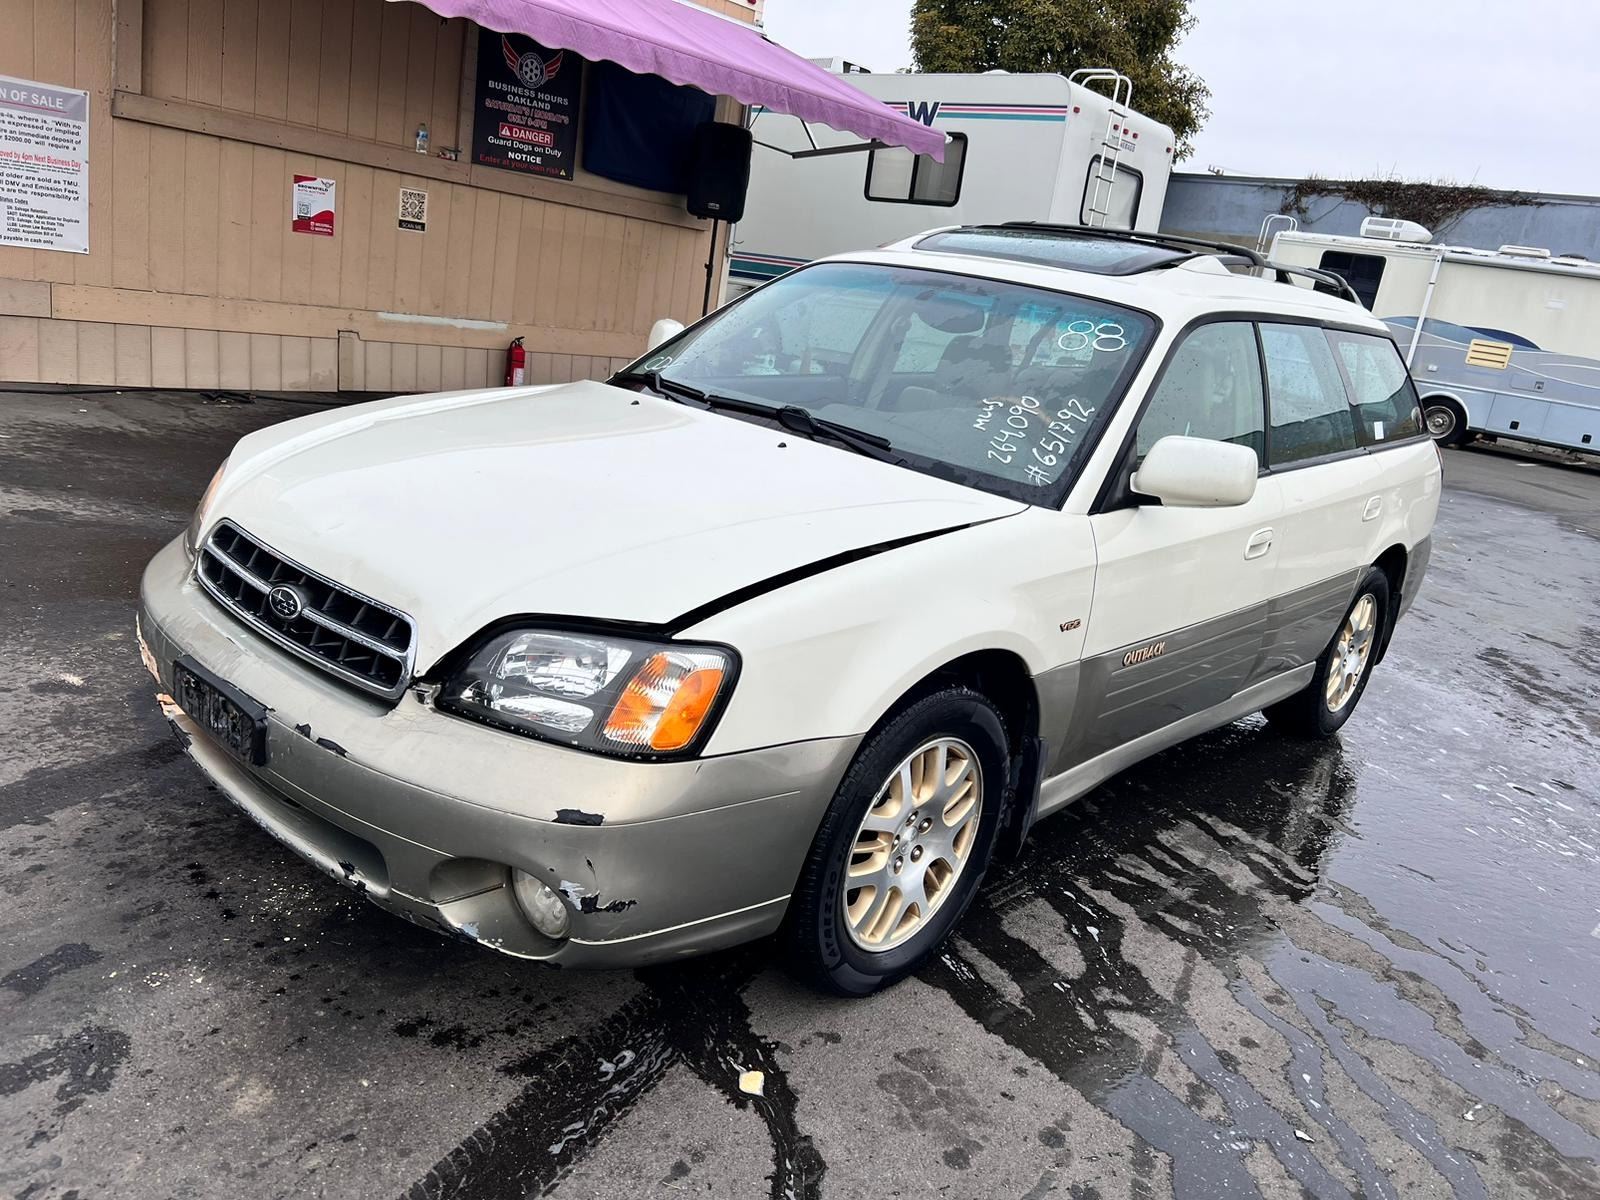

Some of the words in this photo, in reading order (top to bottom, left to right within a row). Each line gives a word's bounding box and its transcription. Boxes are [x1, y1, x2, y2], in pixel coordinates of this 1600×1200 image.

[10, 90, 28, 102] OF
[31, 93, 64, 108] SALE
[488, 80, 536, 98] BUSINESS
[538, 92, 568, 106] HOURS
[507, 94, 551, 110] OAKLAND
[8, 120, 44, 130] expressed
[18, 130, 50, 140] immediate
[52, 136, 74, 145] deposit
[512, 128, 551, 144] DANGER
[488, 136, 512, 147] Guard
[514, 140, 532, 152] Dogs
[545, 147, 562, 158] Duty
[14, 152, 20, 160] by
[22, 152, 33, 162] 4pm
[34, 154, 46, 162] Next
[47, 156, 70, 168] Business
[71, 160, 81, 169] Day
[480, 154, 500, 165] Enter
[512, 161, 528, 169] your
[546, 166, 559, 174] risk
[508, 152, 542, 164] NOTICE
[31, 191, 71, 201] responsibility
[35, 184, 62, 193] Emission
[1058, 320, 1128, 351] 88
[1122, 642, 1166, 667] OUTBACK
